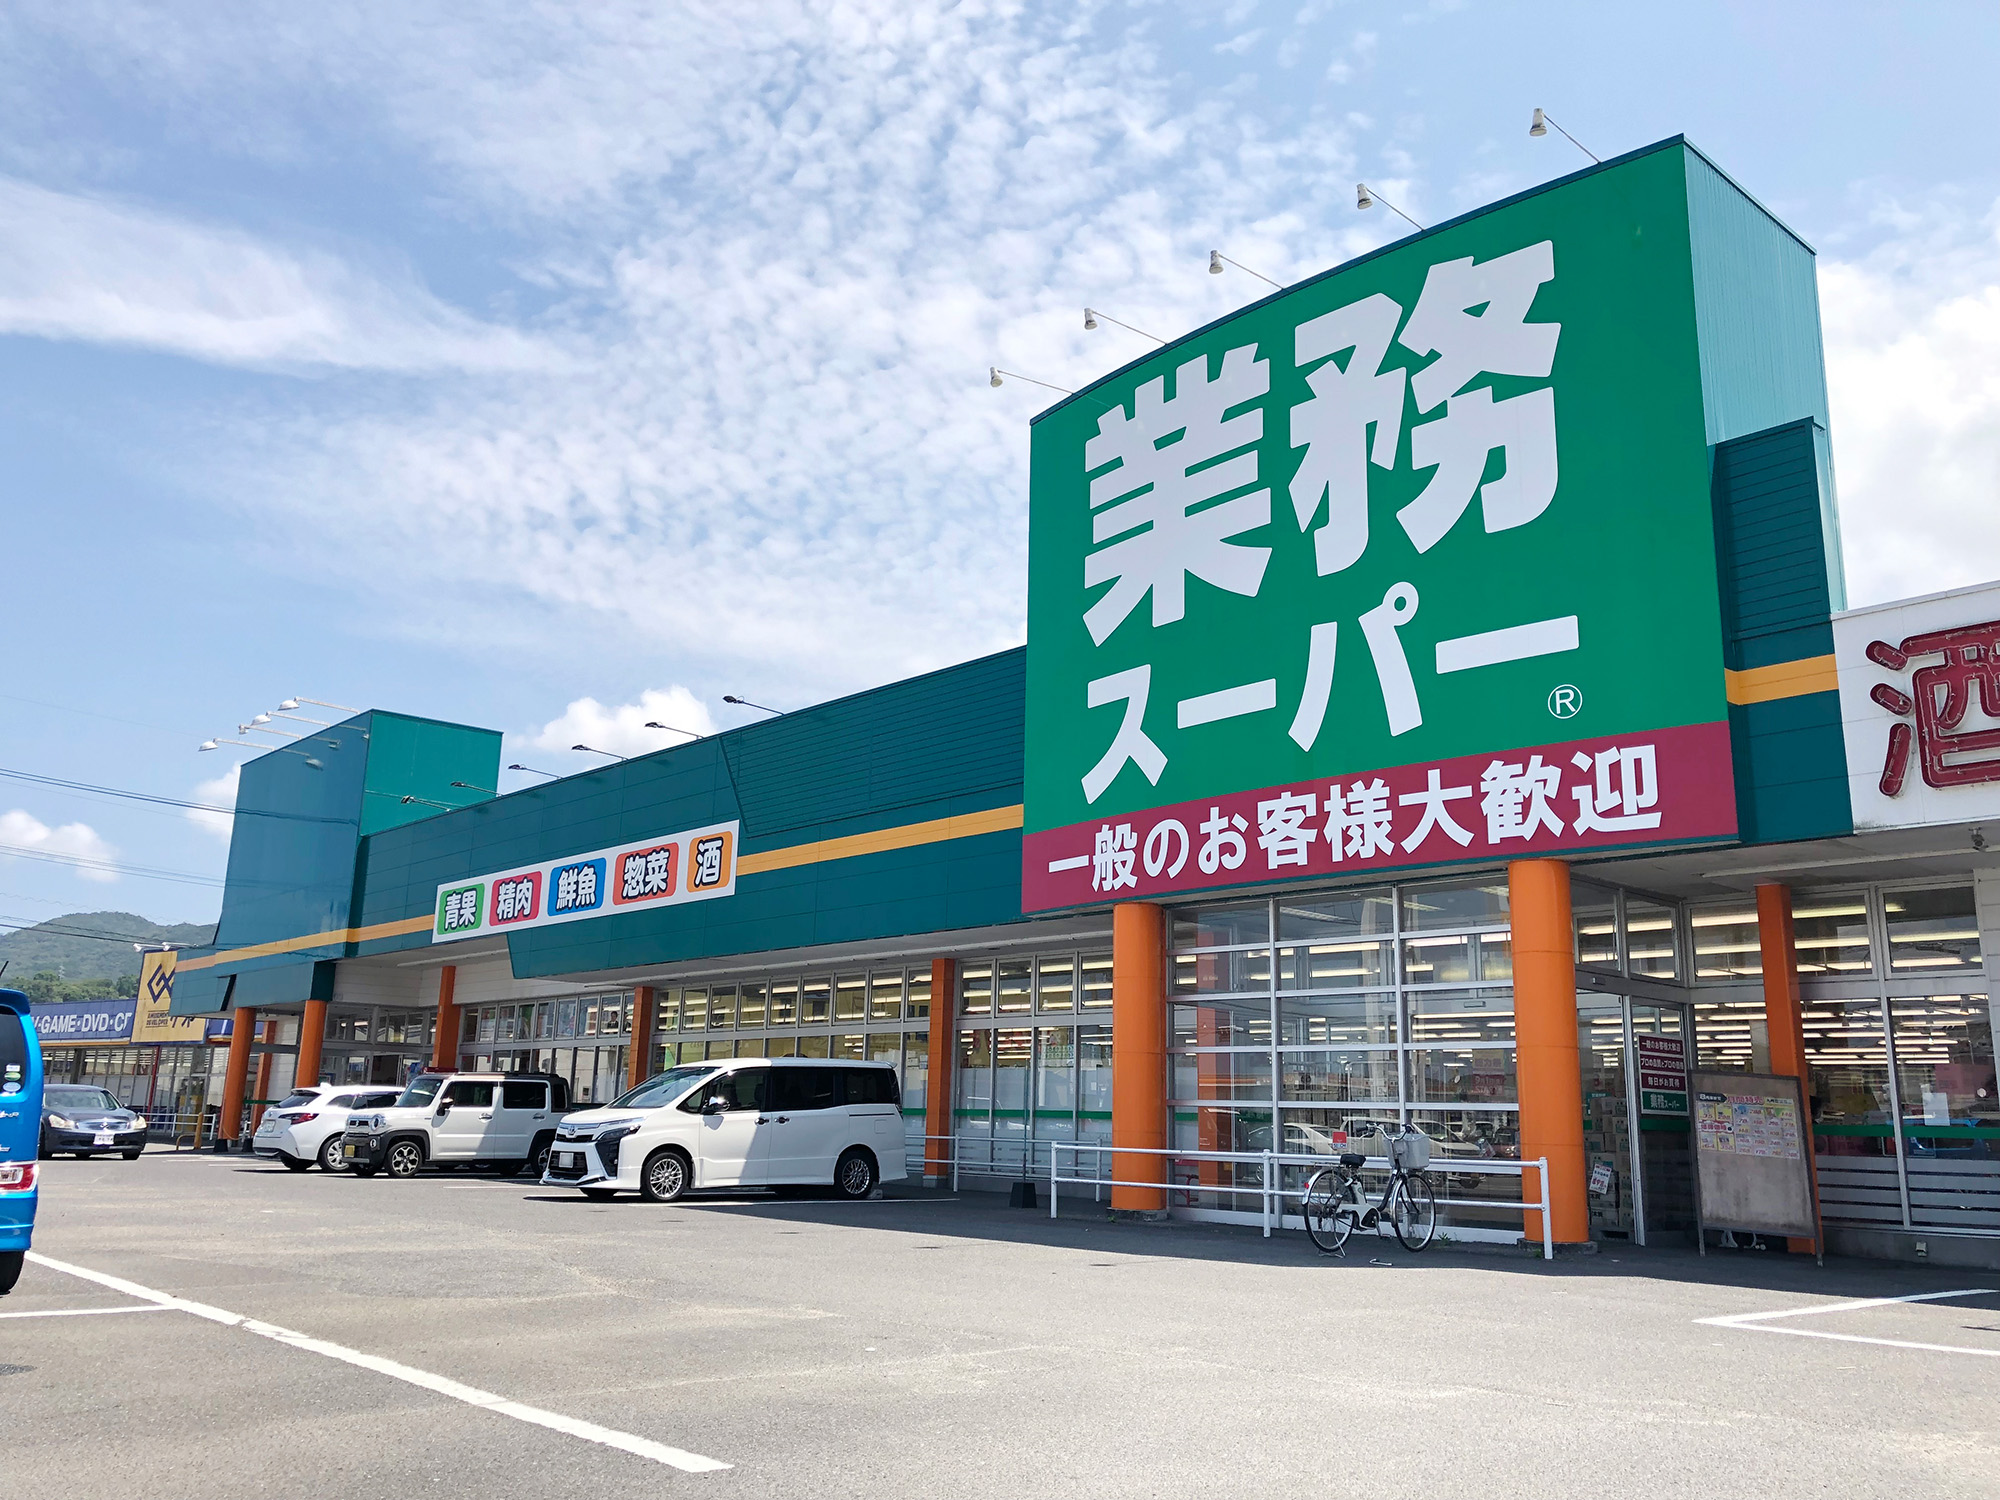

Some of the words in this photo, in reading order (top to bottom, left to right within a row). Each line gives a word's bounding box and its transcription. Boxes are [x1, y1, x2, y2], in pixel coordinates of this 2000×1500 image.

[1083, 240, 1562, 648] 業務
[1081, 581, 1580, 806] スーパー
[444, 888, 477, 931] 青果
[496, 877, 533, 921] 精肉
[556, 863, 597, 911] 鮮魚
[622, 849, 670, 898] 惣菜
[694, 838, 723, 887] 酒
[1048, 744, 1662, 893] 一般のお客様大歓迎
